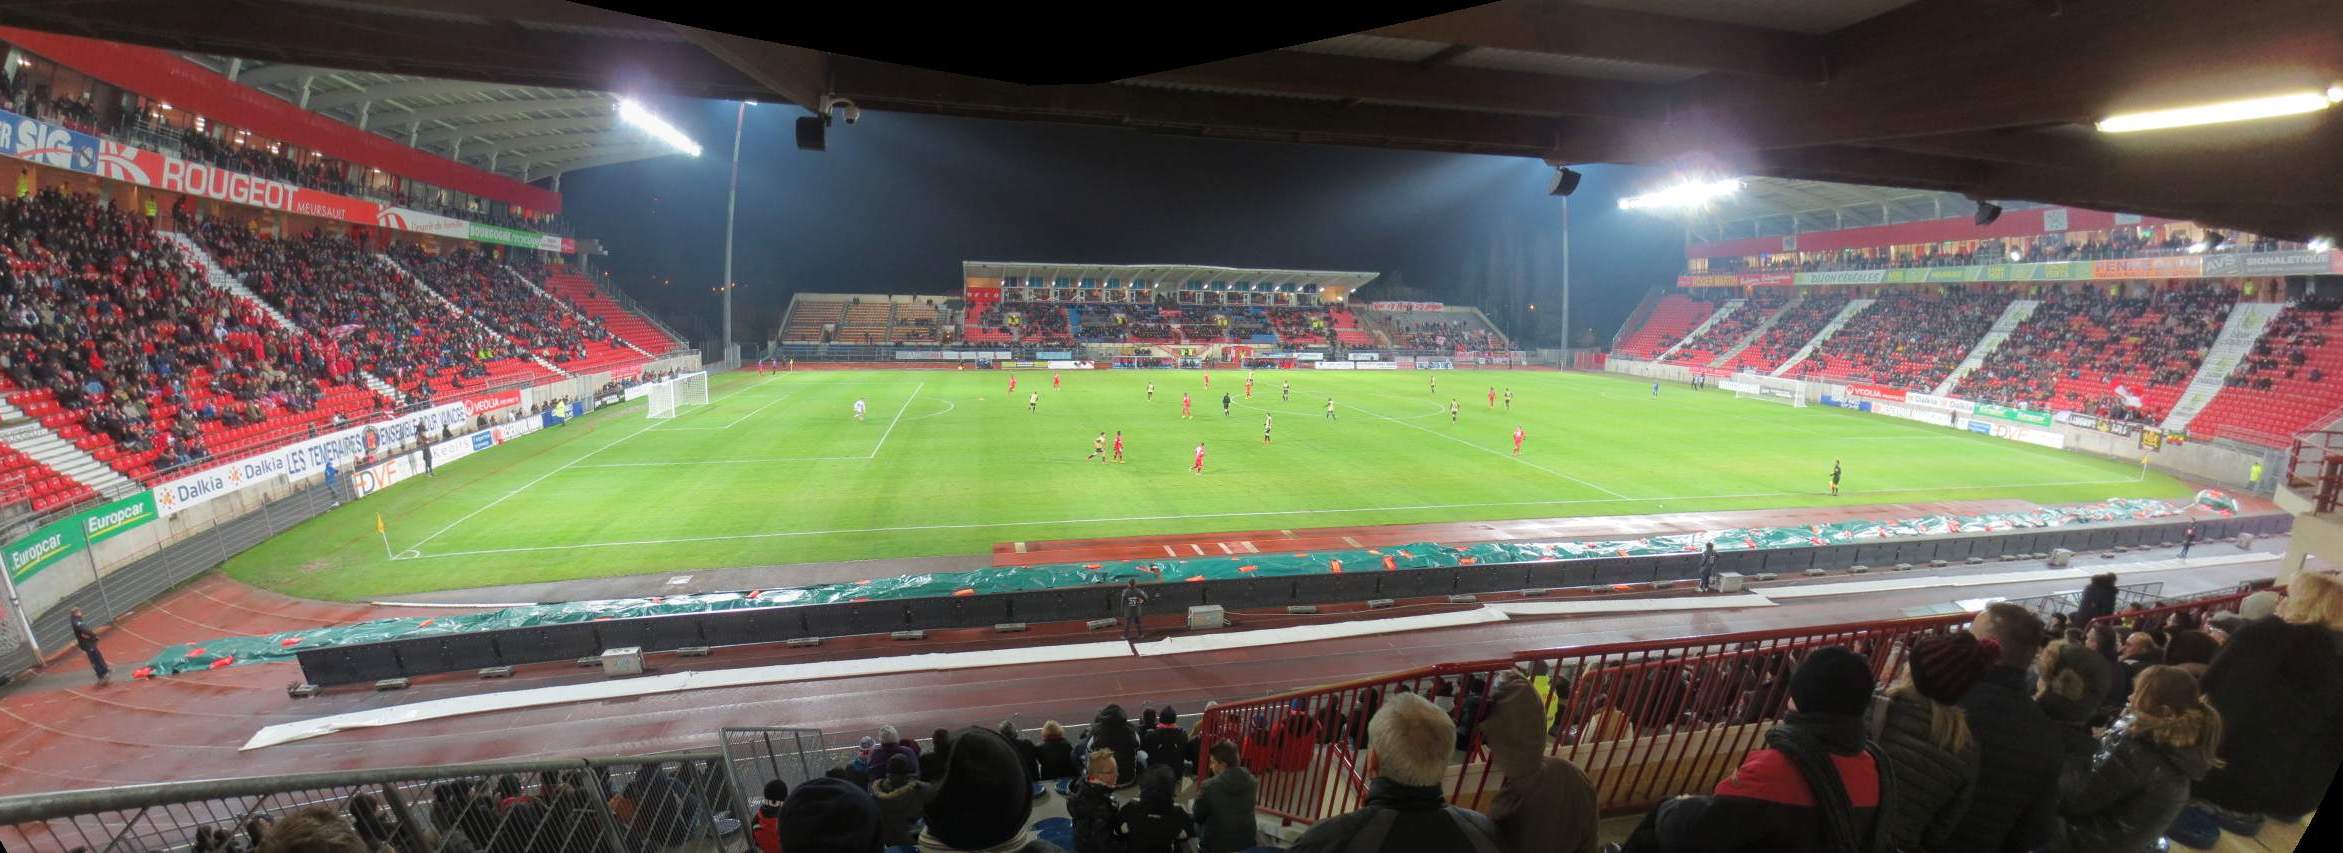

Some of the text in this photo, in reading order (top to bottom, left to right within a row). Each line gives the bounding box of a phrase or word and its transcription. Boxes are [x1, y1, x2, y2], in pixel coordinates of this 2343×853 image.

[16, 120, 73, 169] SIG
[161, 156, 300, 211] ROUGEOT
[297, 202, 346, 220] MEURSAULT
[2206, 254, 2236, 272] AVS
[474, 398, 499, 412] VEOLIA
[287, 449, 307, 475] LES
[308, 433, 363, 468] TEMERAIRES
[379, 416, 418, 447] ENSEMBLE
[244, 458, 284, 480] Dalkia
[178, 475, 224, 503] Dalkia
[88, 500, 144, 533] Europcar
[11, 532, 62, 570] Europcar
